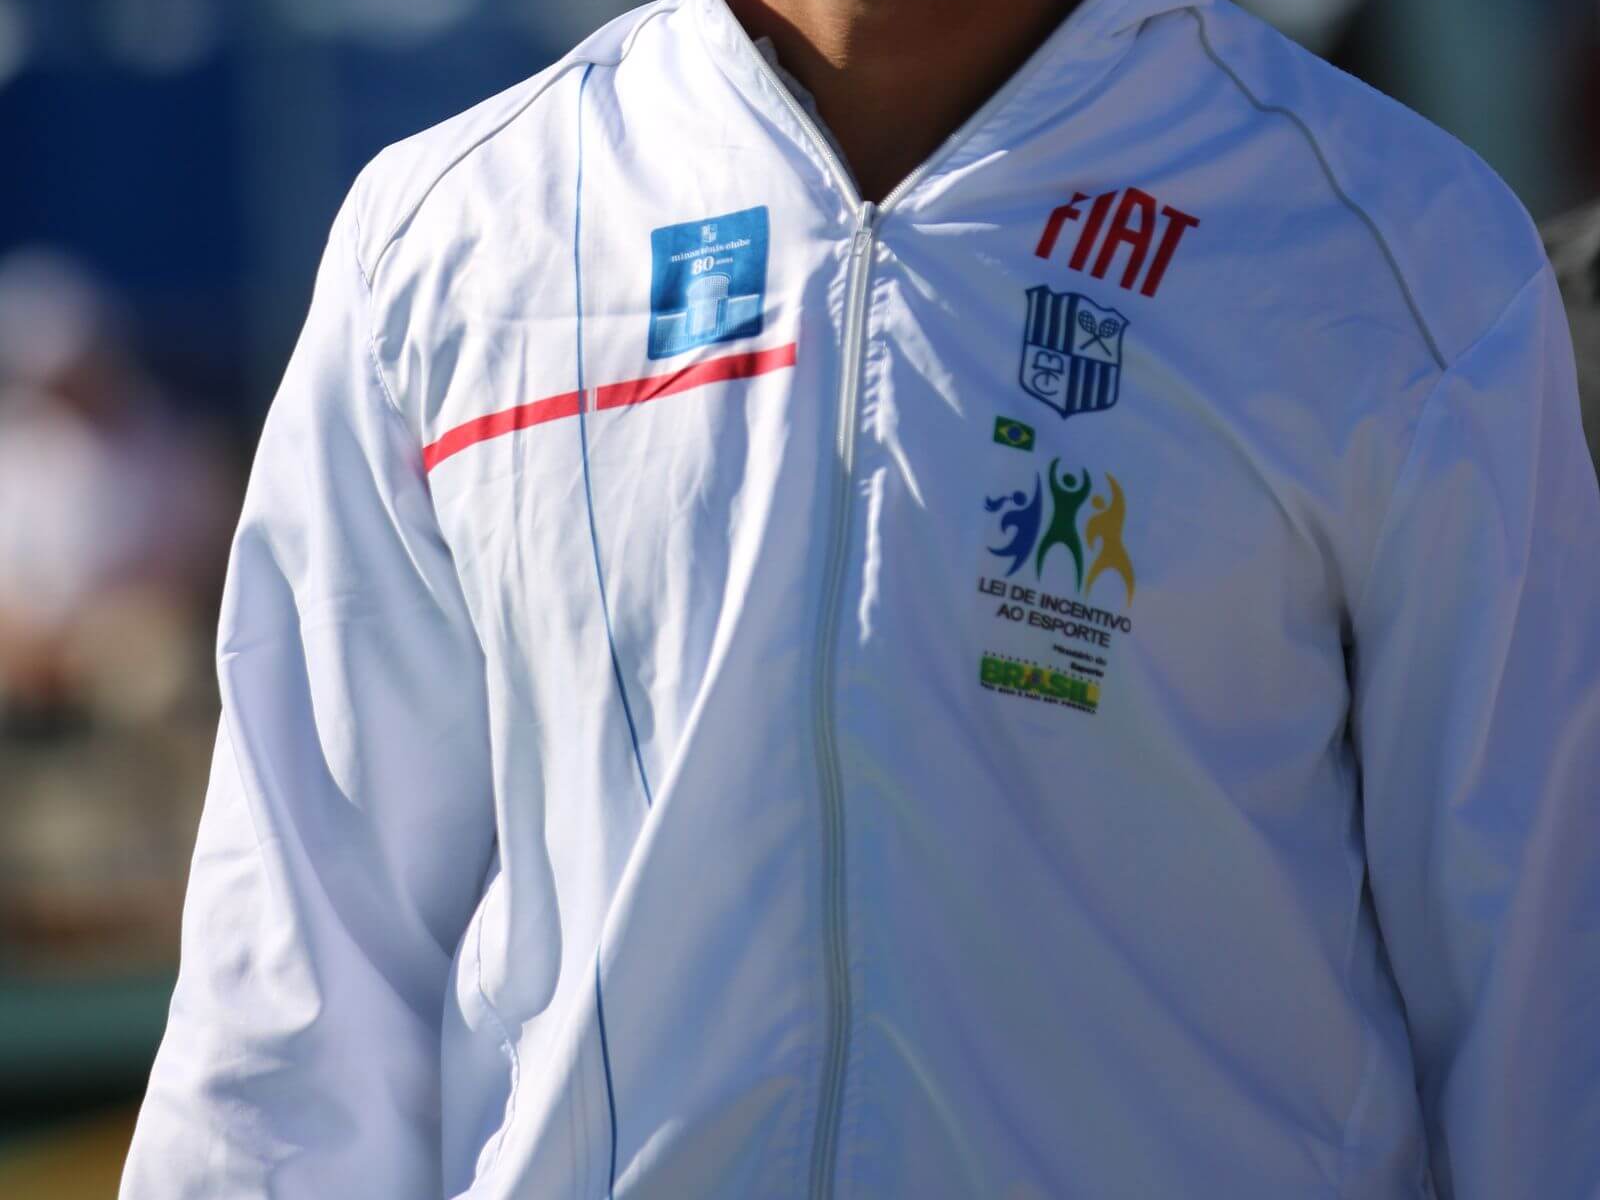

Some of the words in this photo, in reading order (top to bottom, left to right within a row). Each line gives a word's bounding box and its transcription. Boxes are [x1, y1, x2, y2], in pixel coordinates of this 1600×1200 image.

[691, 255, 715, 276] 80
[1034, 186, 1200, 298] FIAT
[978, 577, 1007, 596] LEI
[1010, 584, 1036, 606] DE
[1040, 593, 1132, 633] INCENTIVO
[996, 603, 1024, 622] AO
[1028, 611, 1111, 649] ESPORTE
[980, 656, 1098, 708] BRASIL
